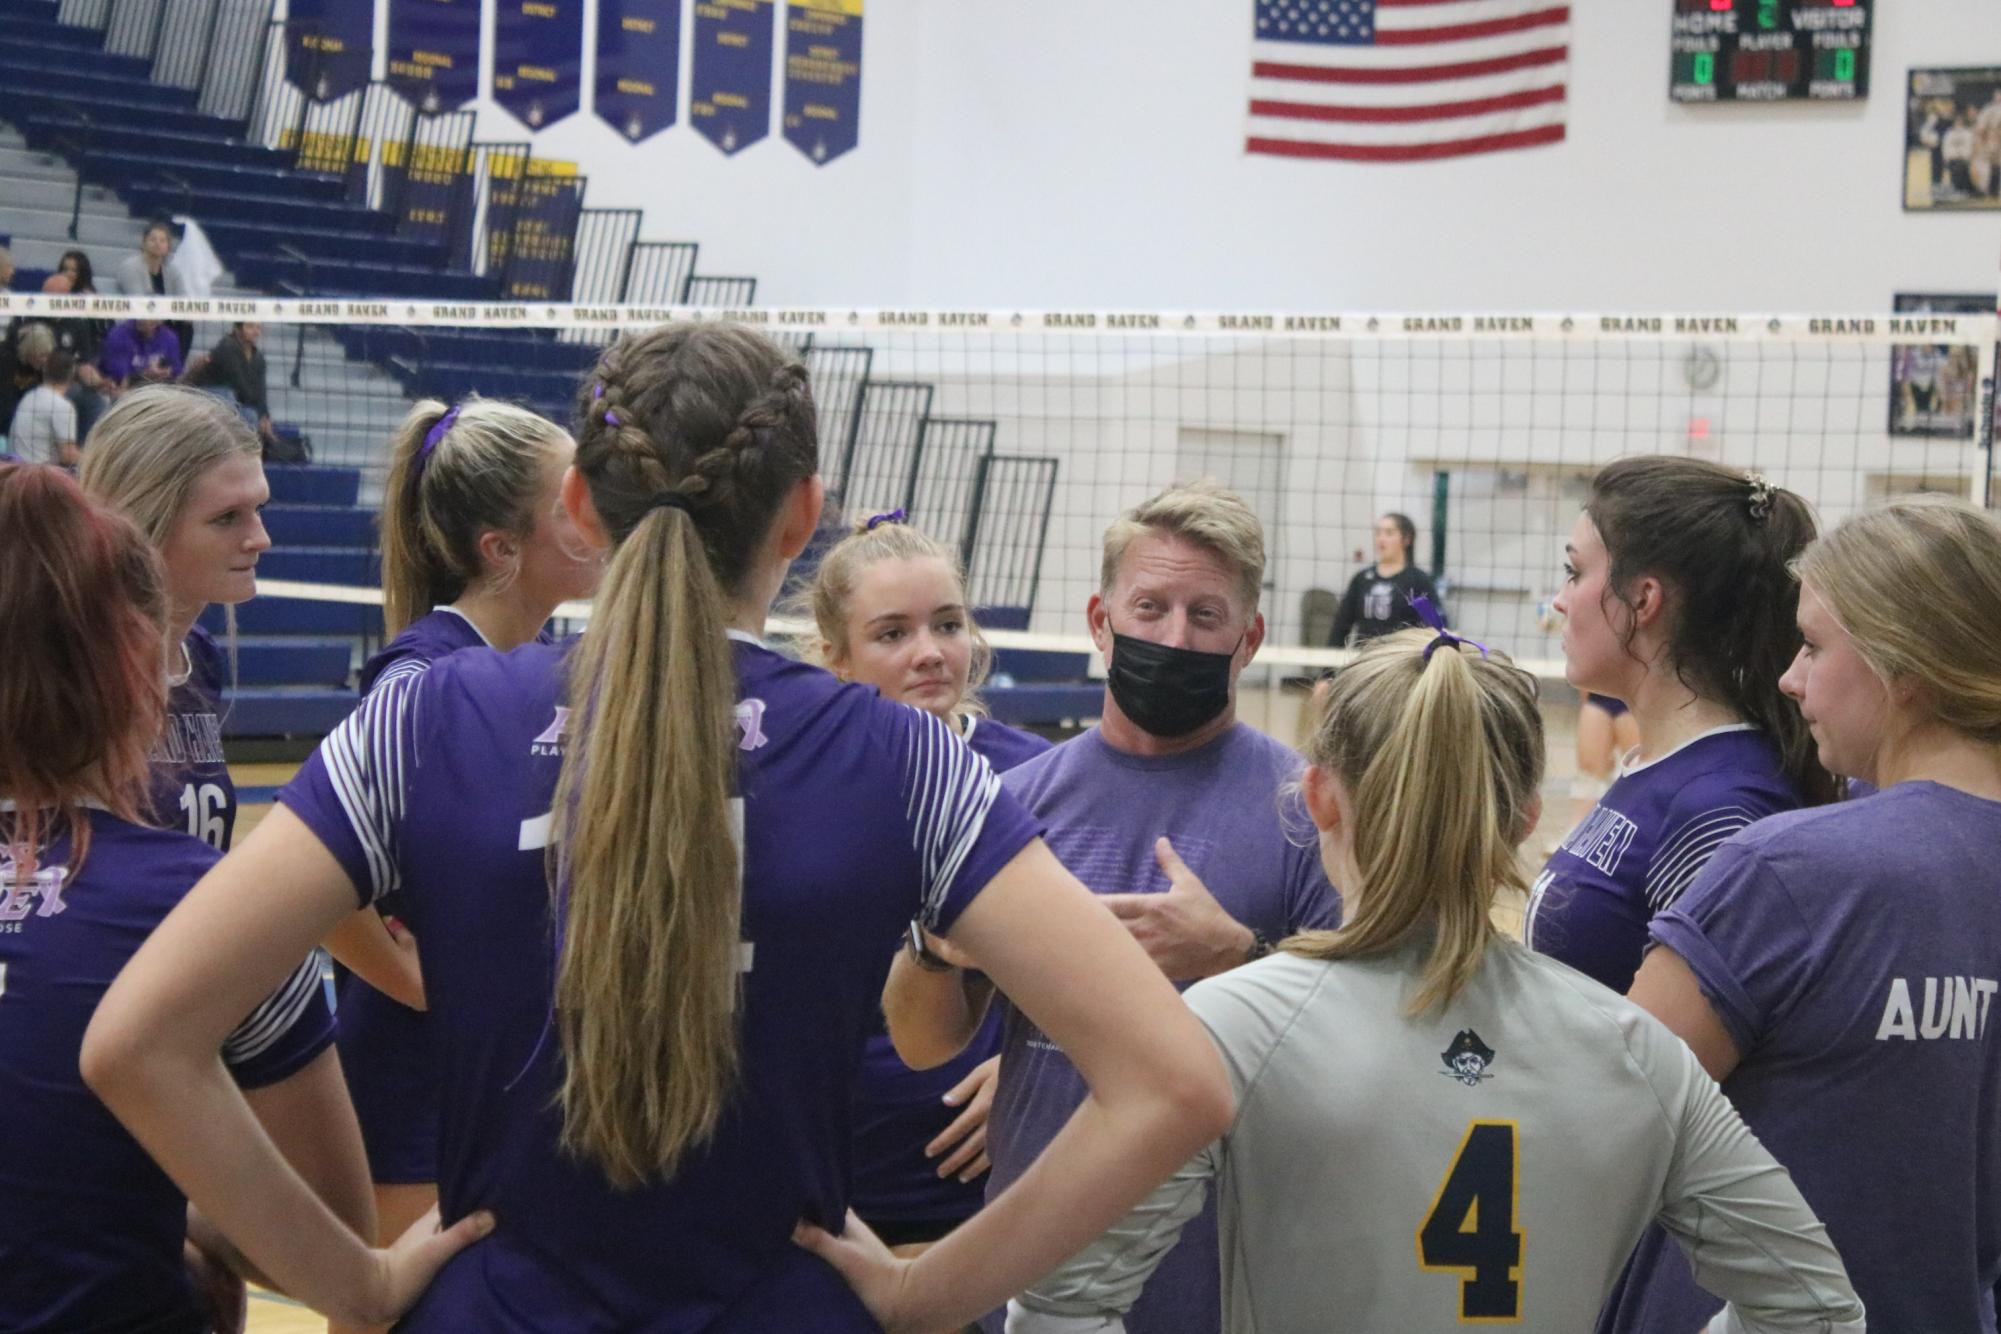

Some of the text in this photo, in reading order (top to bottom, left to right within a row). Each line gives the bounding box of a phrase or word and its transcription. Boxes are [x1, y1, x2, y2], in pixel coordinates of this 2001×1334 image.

[1674, 8, 1865, 33] HOME VISITOR
[1694, 48, 1855, 84] 0 0
[49, 299, 130, 312] GRAND HAVEN
[171, 301, 255, 314] GRAND HAVEN
[299, 304, 387, 317] GRAND HAVEN
[433, 306, 526, 319] GRAND HAVEN
[574, 308, 671, 321] GRAND HAVEN
[778, 312, 825, 324] HAVEN
[879, 312, 988, 326] GRAND HAVEN
[1043, 314, 1159, 328] GRAND HAVEN
[1219, 315, 1341, 330] GRAND HAVEN
[1403, 318, 1532, 332] GRAND HAVEN
[1600, 317, 1738, 333] GRAND HAVEN
[1809, 319, 1956, 335] GRAND HAVEN
[179, 783, 227, 850] 16
[1875, 975, 1999, 1040] AUNT
[1416, 1120, 1527, 1324] 4
